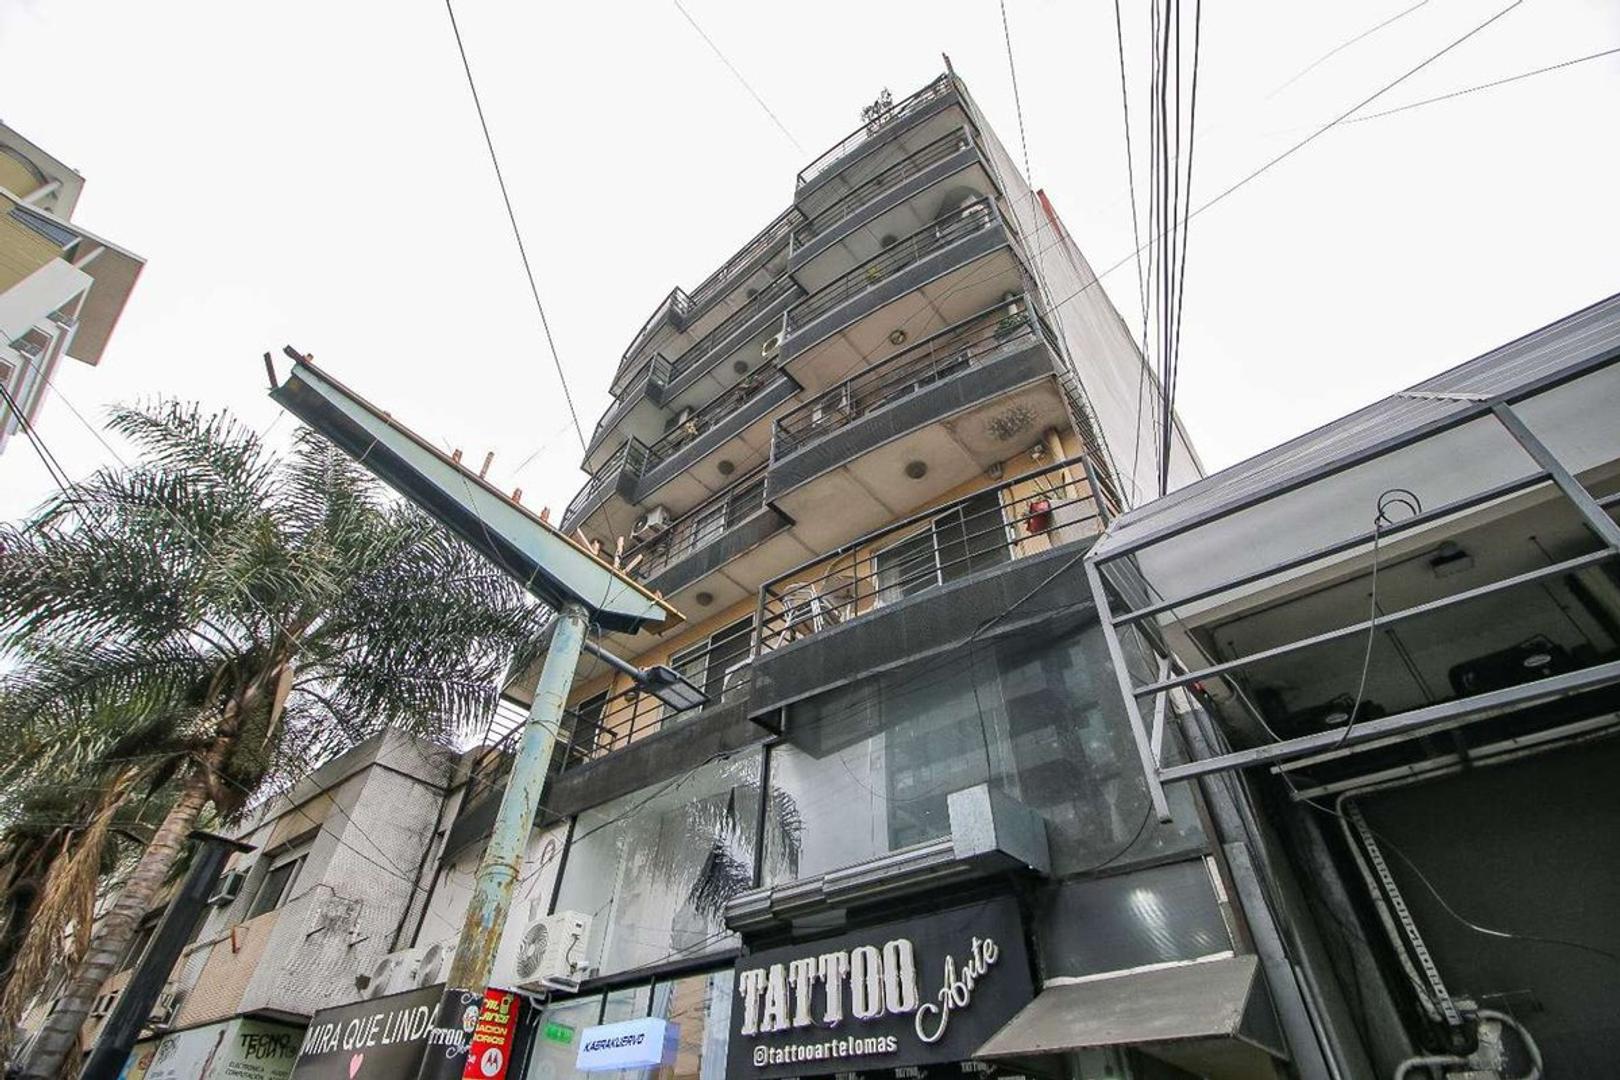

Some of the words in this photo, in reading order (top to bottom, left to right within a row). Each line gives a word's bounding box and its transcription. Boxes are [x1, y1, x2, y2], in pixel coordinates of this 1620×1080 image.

[739, 939, 919, 1036] TATTOO
[915, 936, 999, 1043] Arte
[300, 1022, 342, 1055] MIRA
[343, 1013, 384, 1051] QUE
